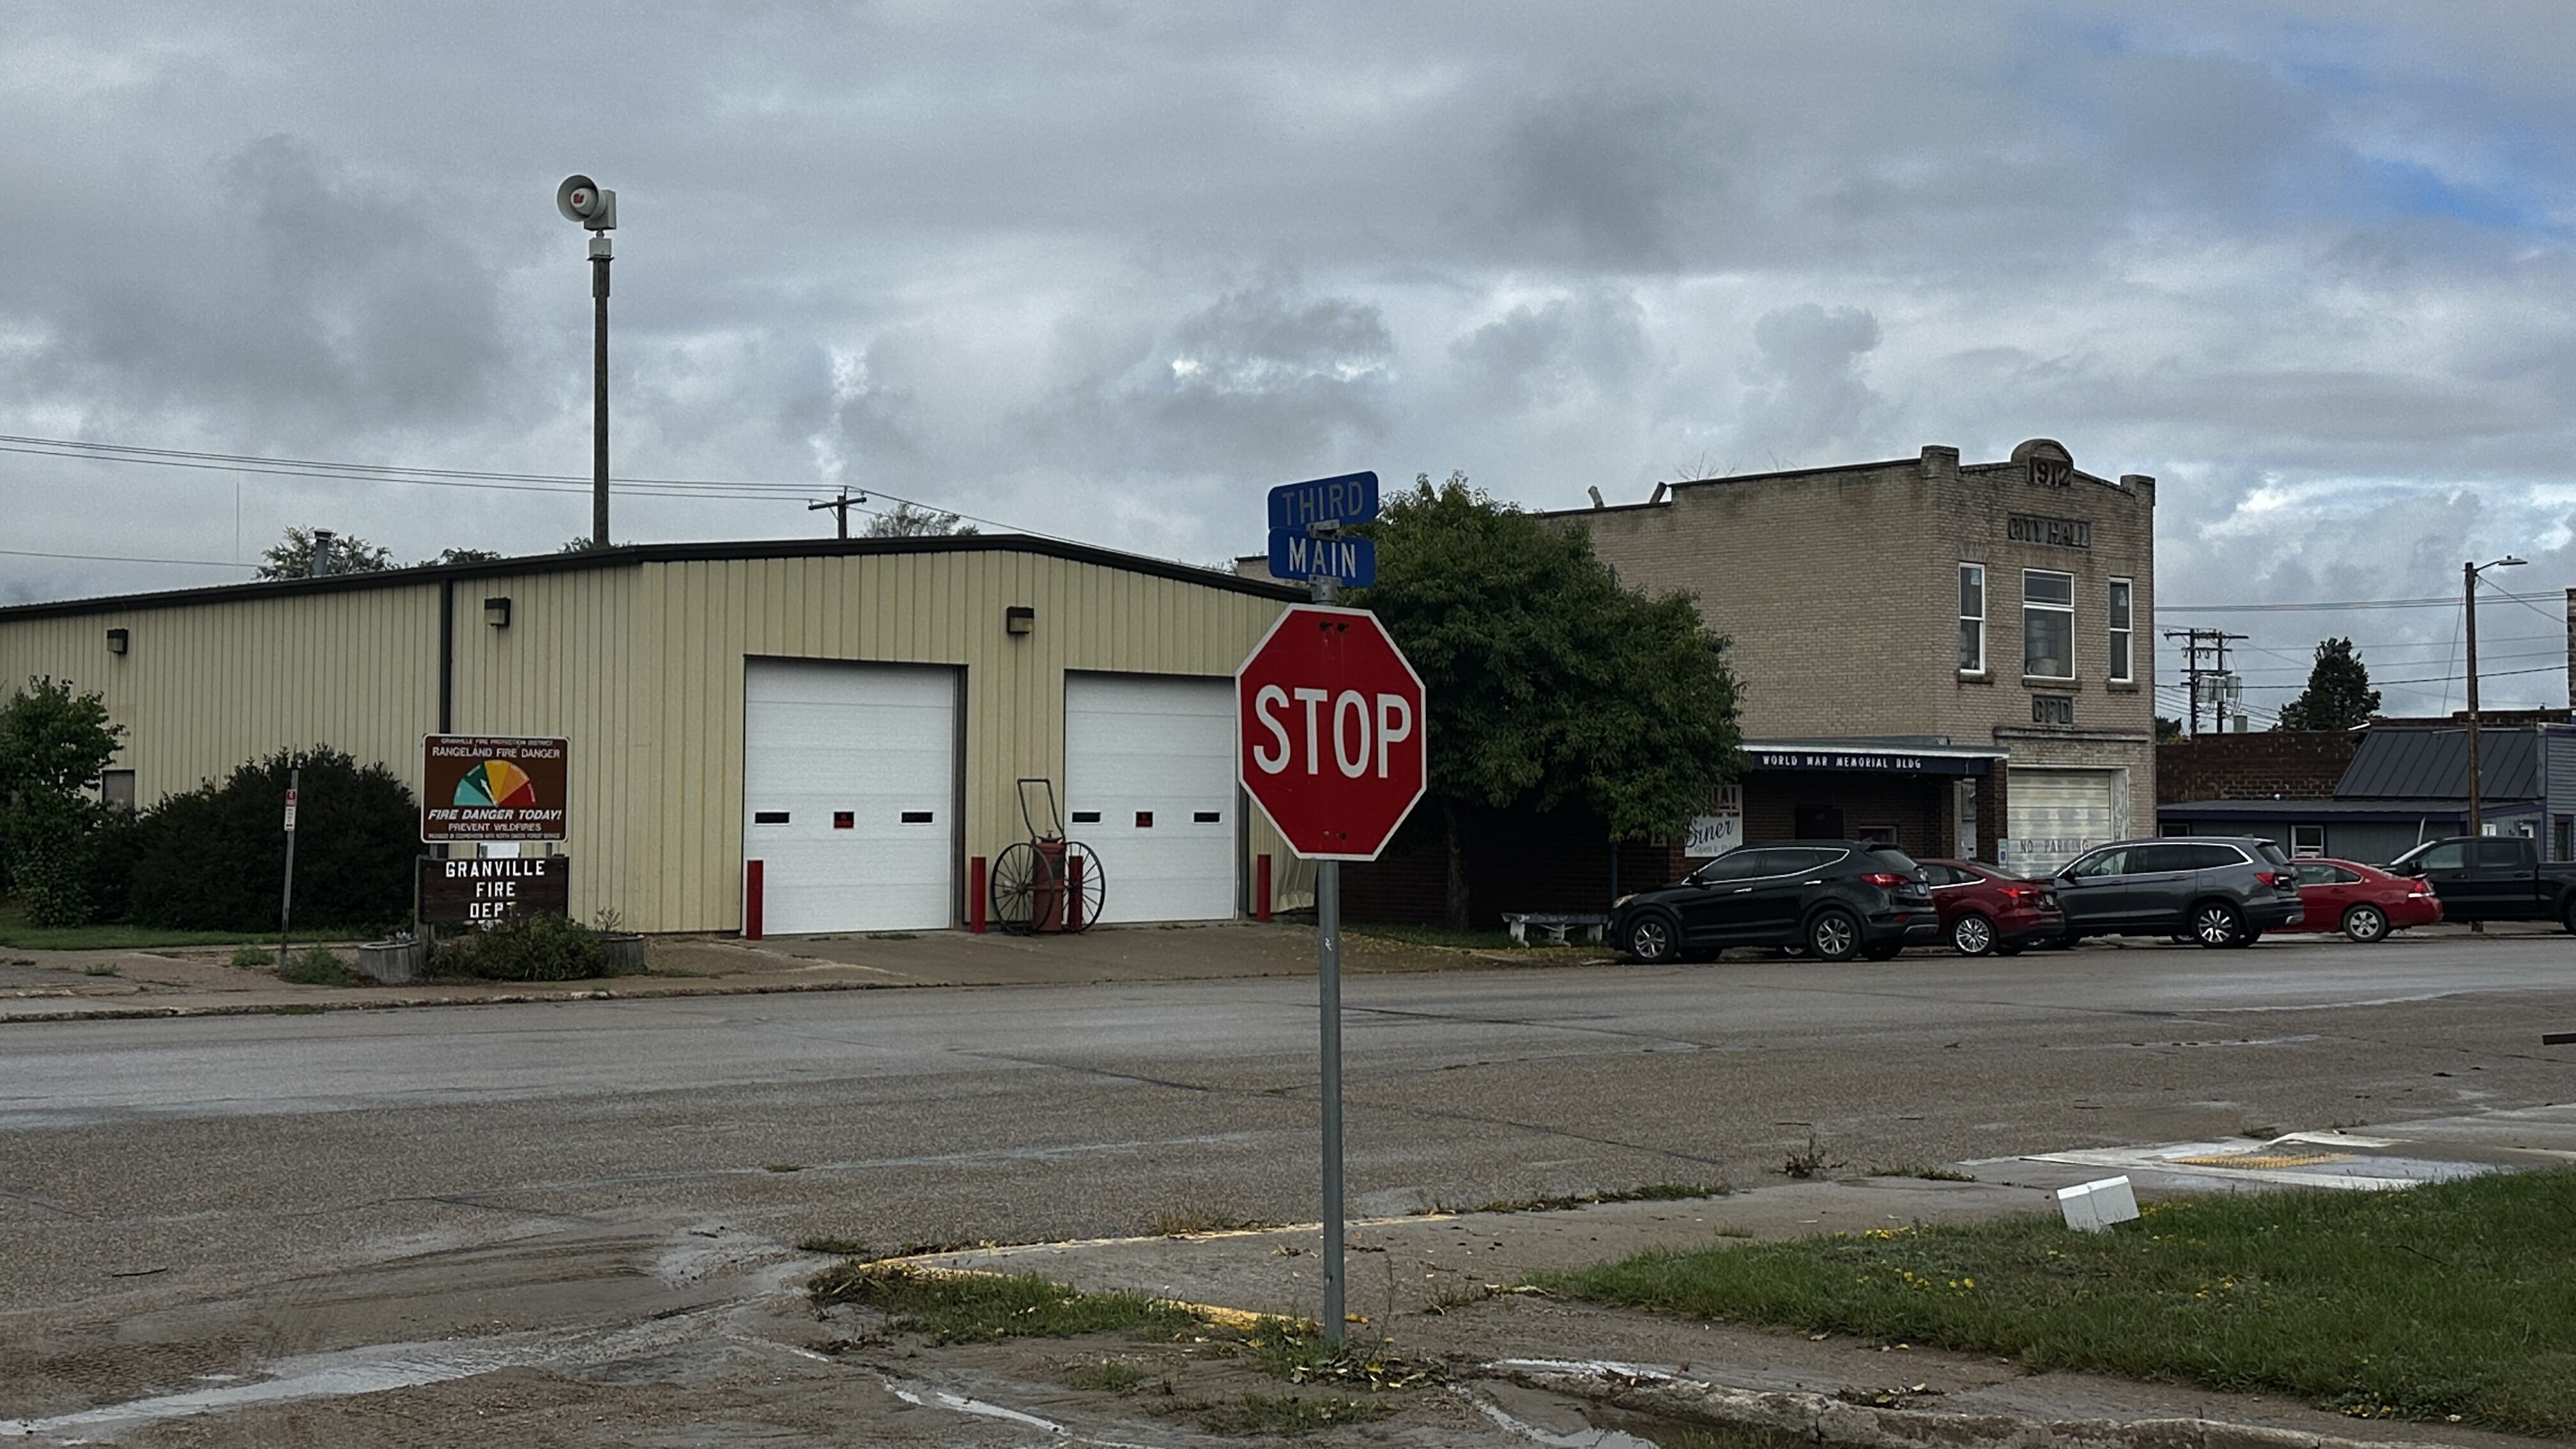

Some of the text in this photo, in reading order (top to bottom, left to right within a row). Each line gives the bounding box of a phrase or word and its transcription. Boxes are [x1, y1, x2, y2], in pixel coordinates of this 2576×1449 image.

[1282, 481, 1363, 526] THIRD
[2008, 516, 2090, 548] CITY HALL
[1289, 537, 1356, 578] MAIN
[1254, 684, 1412, 778] STOP
[432, 746, 560, 758] RANGELAND FIRE DANGER
[1762, 755, 1921, 769] WORLD WAR MEMORIAL BLDG
[428, 809, 562, 820] FIRE DANGER TODAY!
[448, 823, 542, 831] PREVENT WILDFIRES
[2020, 839, 2089, 853] NO PARKING
[445, 861, 545, 877] GRANVILLE
[476, 882, 516, 897] FIRE
